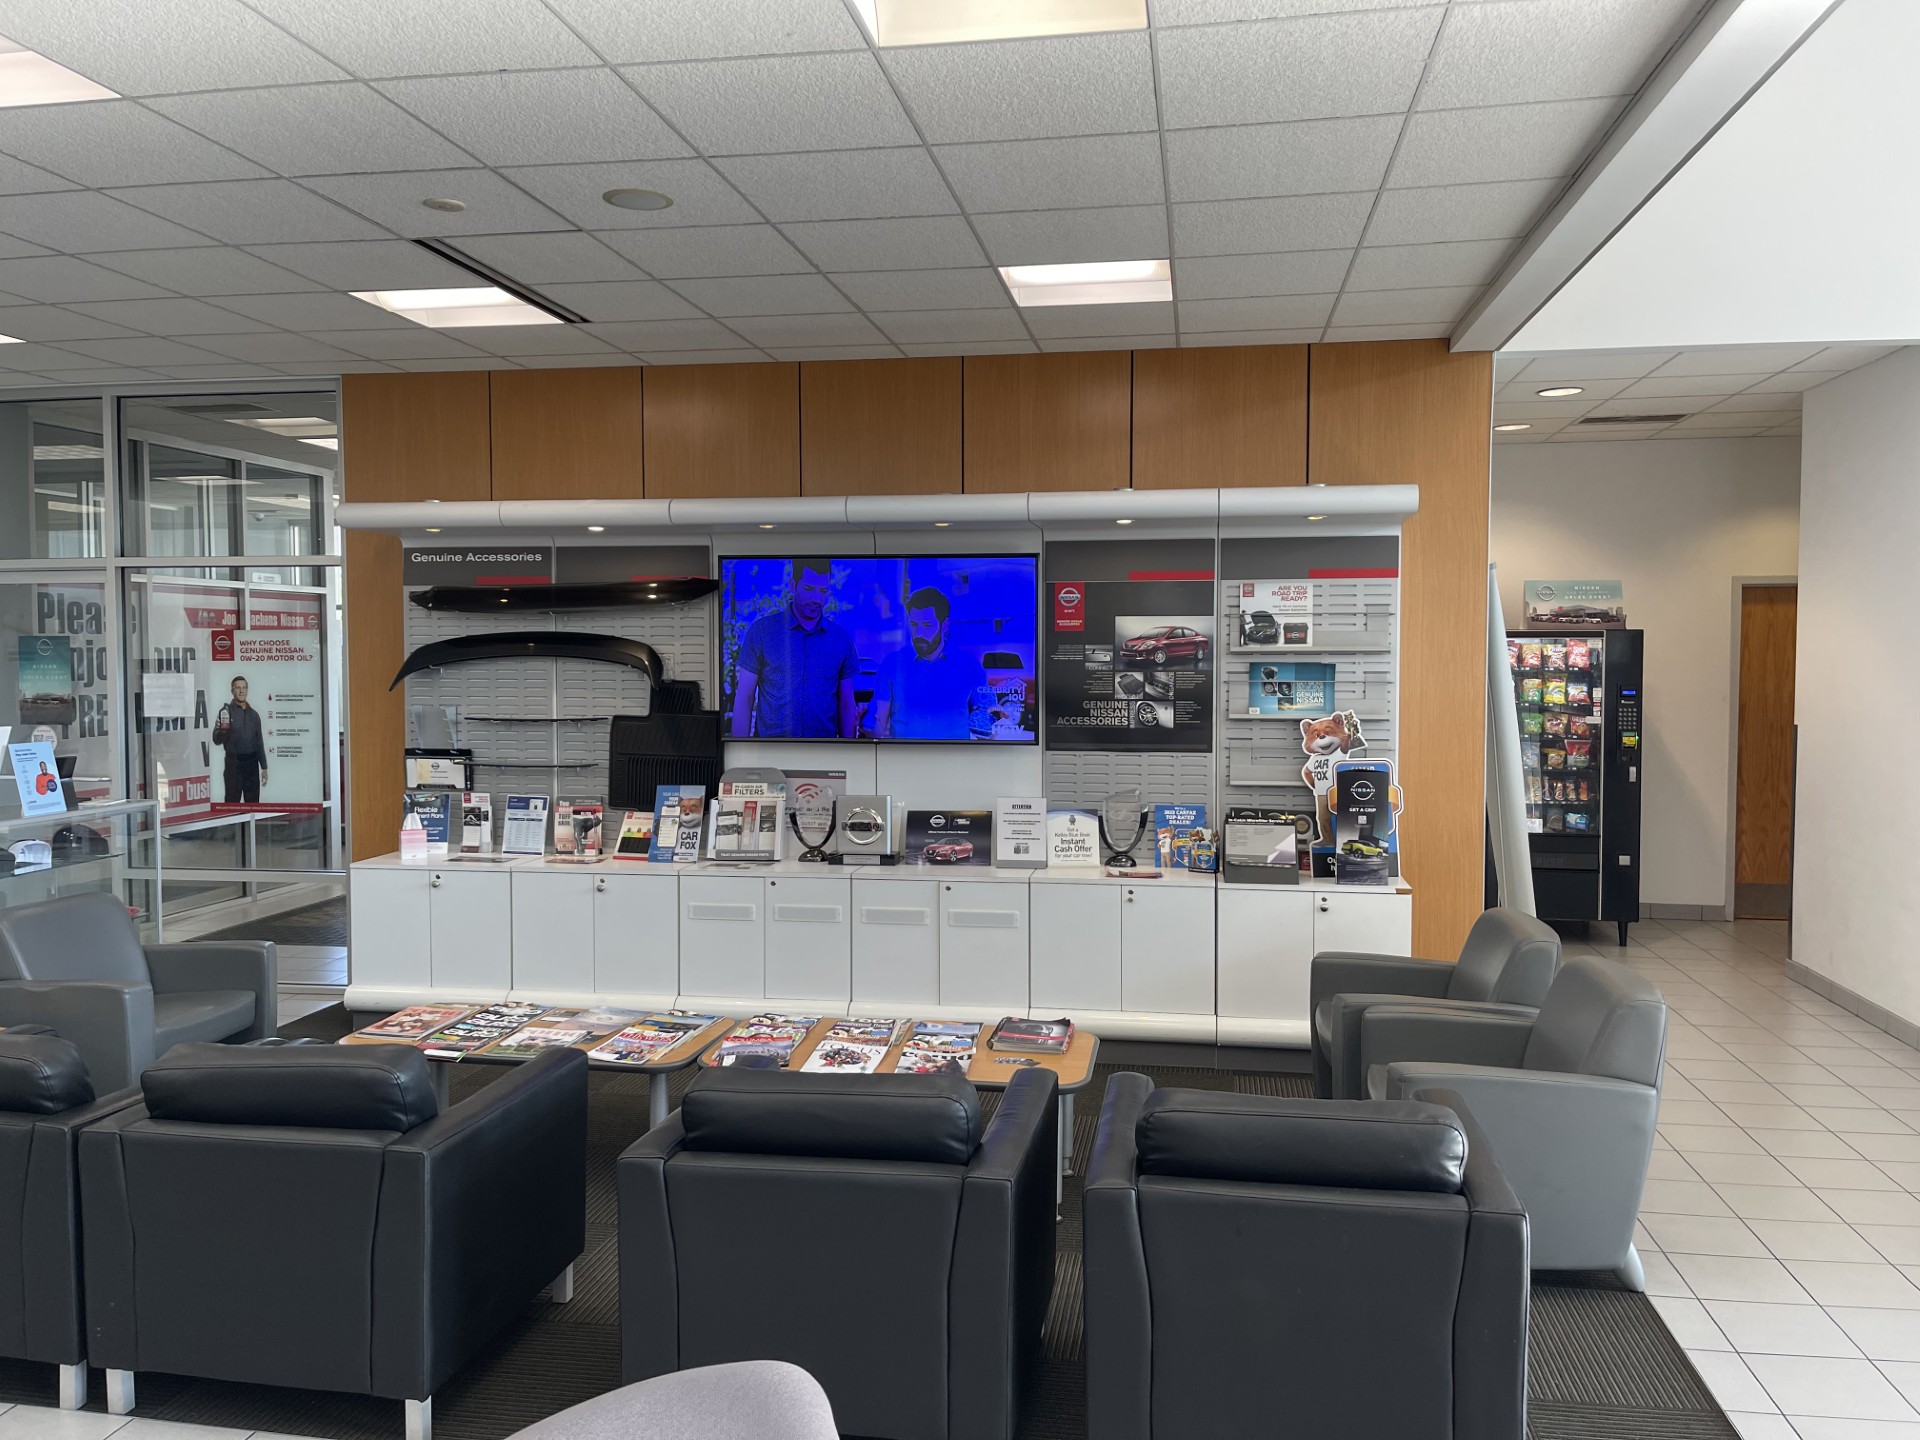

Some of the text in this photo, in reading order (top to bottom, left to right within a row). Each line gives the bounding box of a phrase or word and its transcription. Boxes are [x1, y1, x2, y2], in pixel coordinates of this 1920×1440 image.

[411, 552, 543, 562] Genuine Accessories
[222, 611, 236, 625] Joe
[250, 612, 278, 626] achens
[280, 614, 304, 627] Nissan
[1083, 701, 1129, 709] GENUINE
[1090, 709, 1129, 717] NISSAN
[1057, 717, 1129, 726] ACCESSORIES
[1313, 759, 1329, 770] CAR
[1313, 769, 1329, 781] FOX
[734, 788, 765, 796] FILTERS
[680, 831, 698, 841] CAR
[680, 841, 697, 850] FOX
[1060, 837, 1086, 845] Instant
[1054, 845, 1093, 853] Cash Offer
